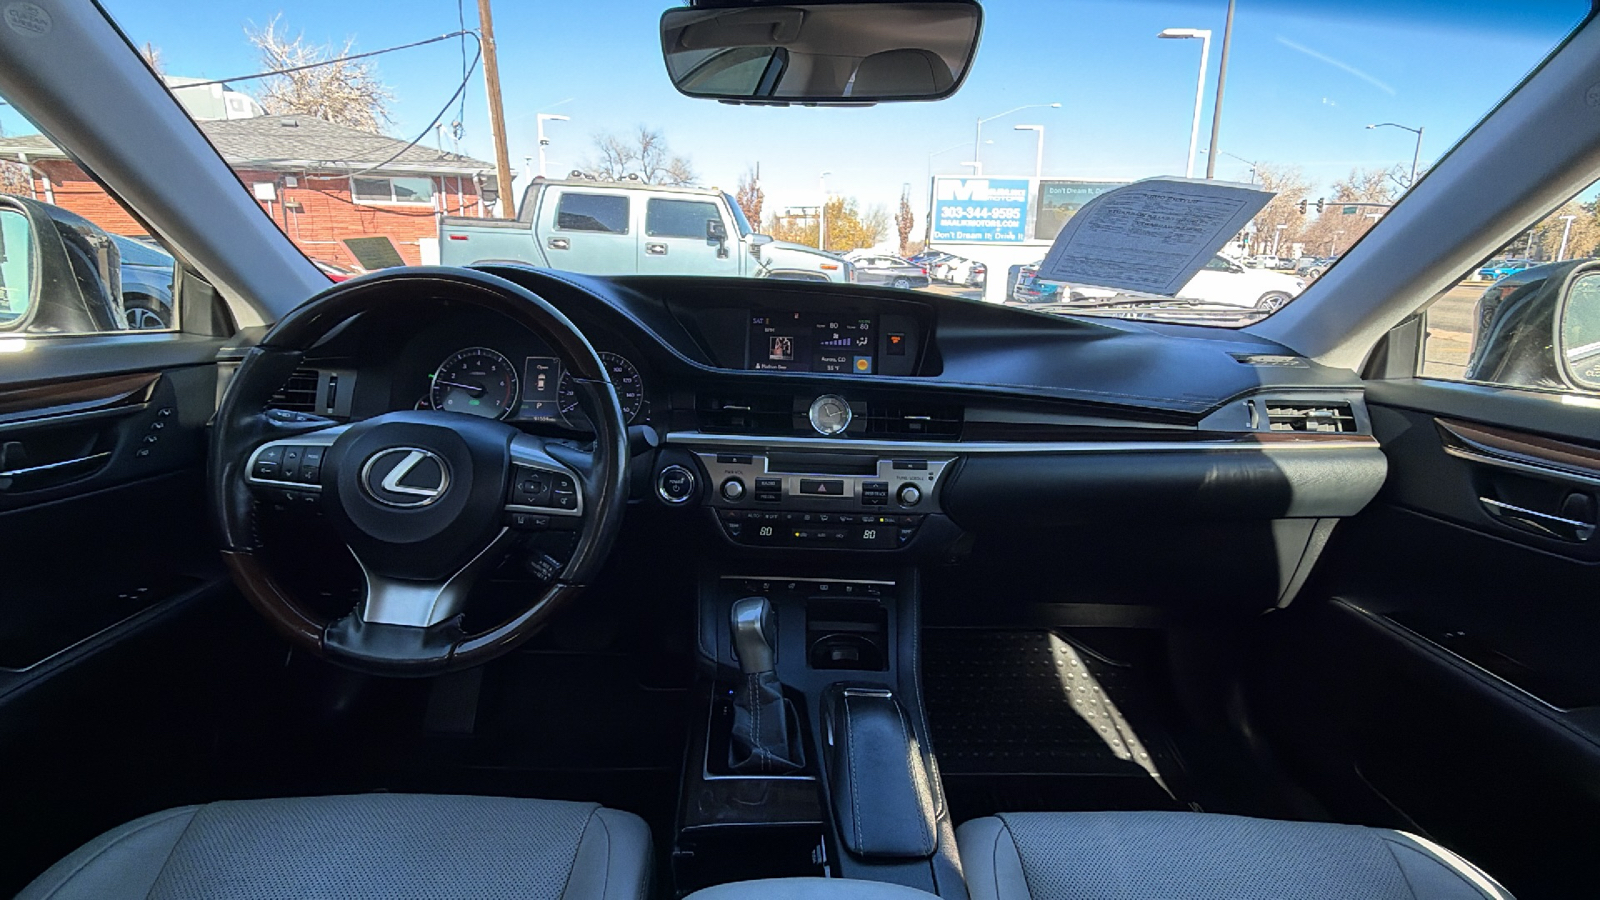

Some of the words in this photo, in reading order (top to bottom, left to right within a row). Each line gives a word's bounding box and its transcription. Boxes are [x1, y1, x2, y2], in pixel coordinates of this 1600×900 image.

[934, 231, 955, 239] Don't
[957, 231, 982, 239] Dream
[760, 526, 773, 536] 80
[863, 529, 876, 539] 80
